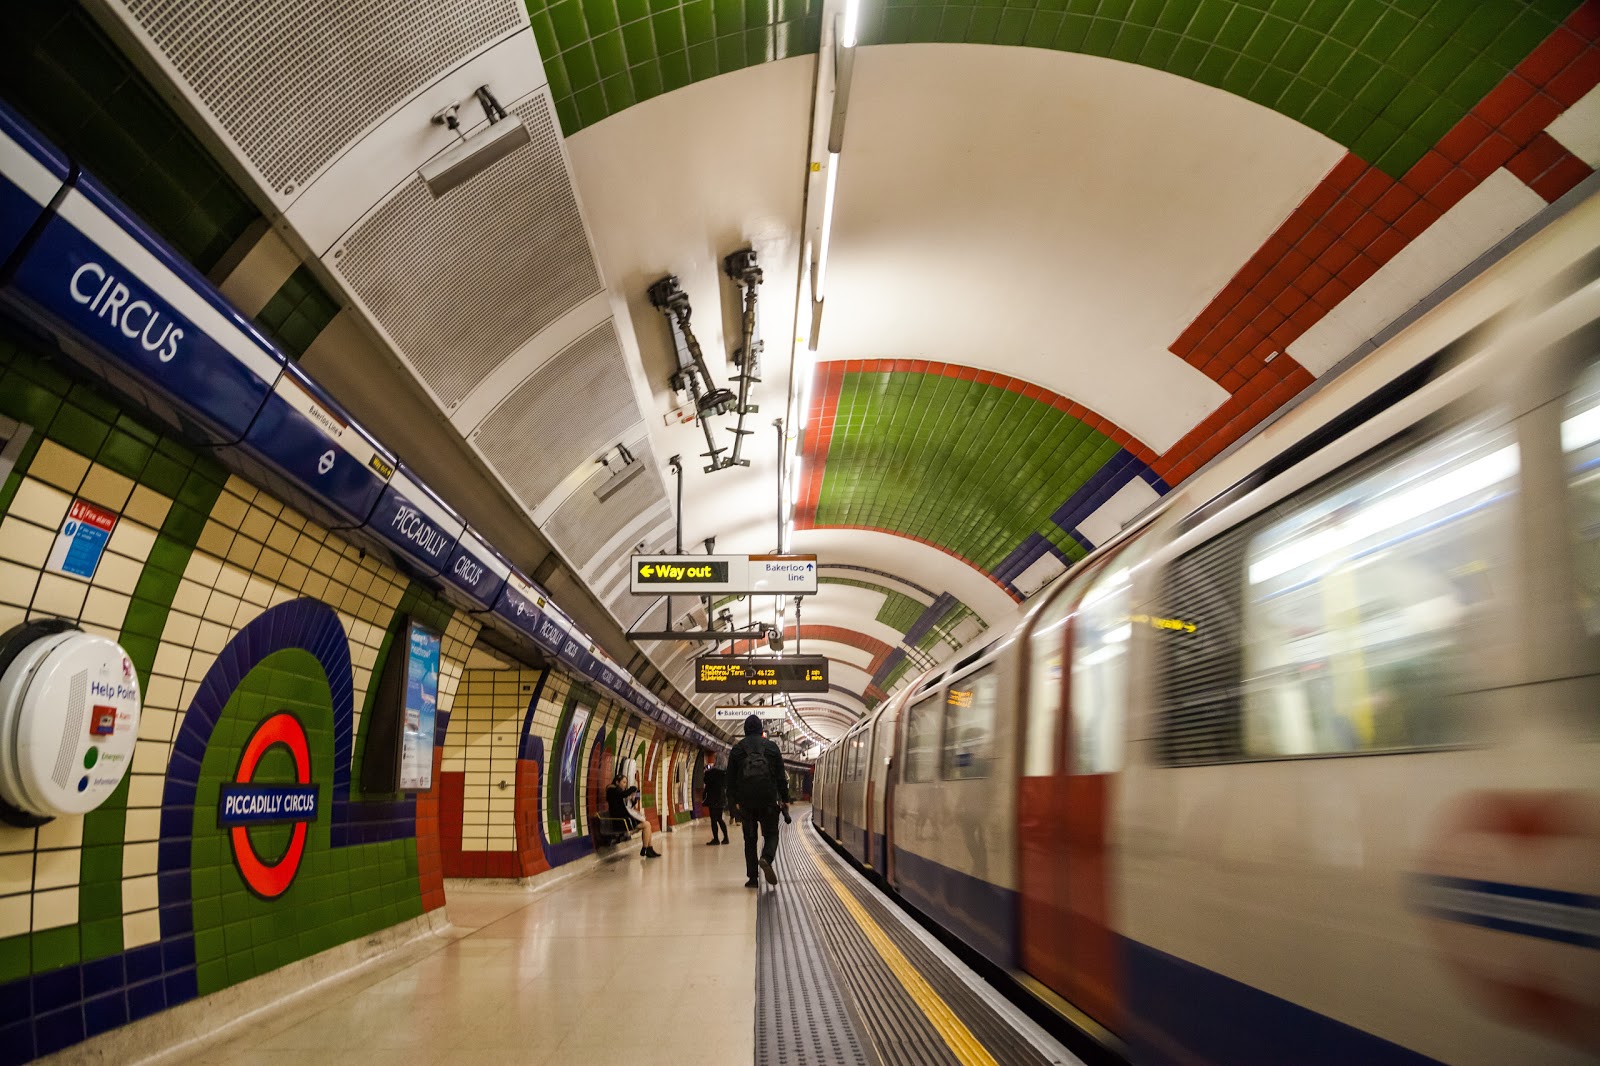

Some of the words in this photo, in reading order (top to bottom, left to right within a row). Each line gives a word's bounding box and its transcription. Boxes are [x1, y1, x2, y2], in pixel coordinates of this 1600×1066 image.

[70, 262, 184, 363] CIRCUS
[309, 405, 329, 427] Bakerloo
[328, 422, 339, 435] Line
[85, 509, 97, 520] Fire
[96, 515, 112, 527] alarm
[391, 505, 447, 558] PICCADILLY
[454, 555, 483, 586] CIRCUS
[656, 565, 686, 580] Way
[687, 565, 712, 578] out
[765, 563, 804, 572] Bakerloo
[91, 681, 115, 700] Help
[117, 684, 136, 701] Point
[724, 708, 751, 716] Bakerloo
[753, 707, 766, 716] line
[225, 794, 283, 815] PICCADILLY
[284, 794, 315, 812] CIRCUS
